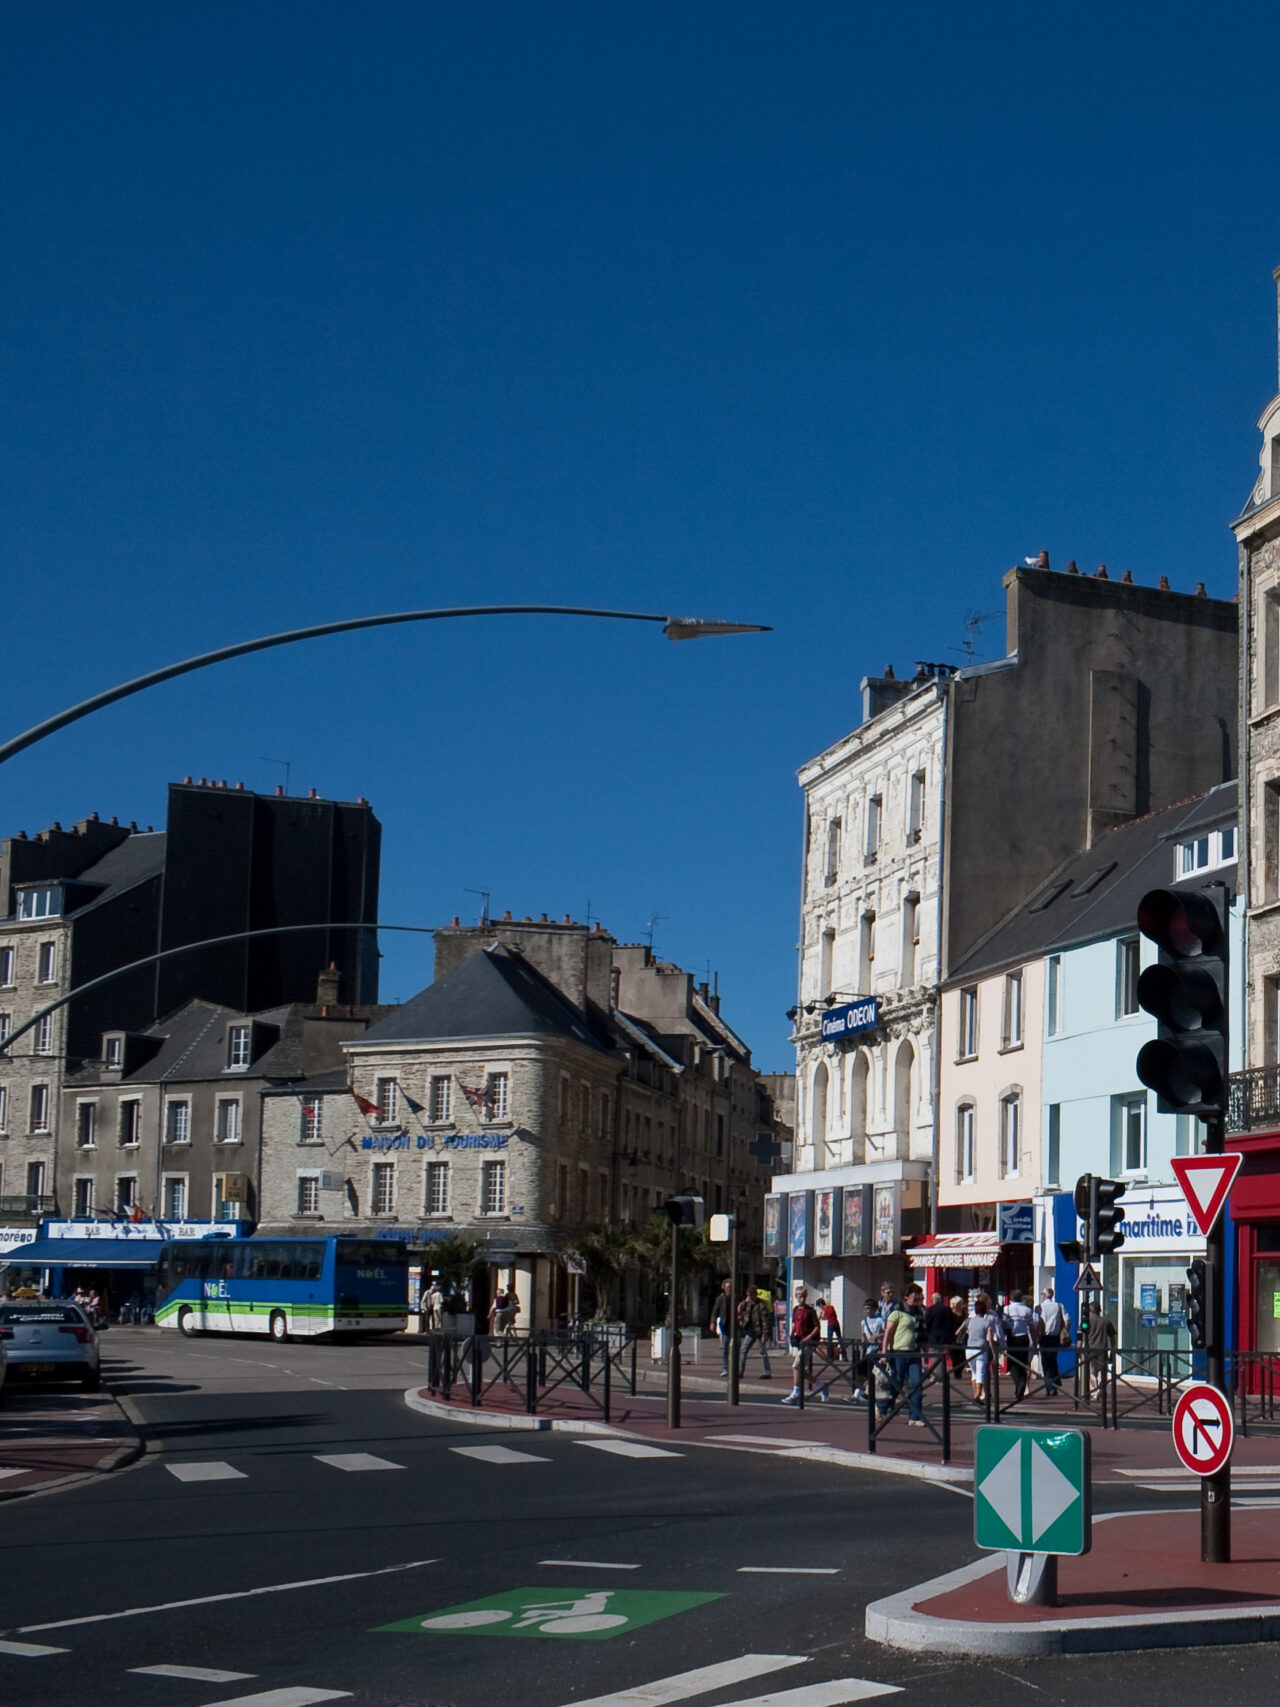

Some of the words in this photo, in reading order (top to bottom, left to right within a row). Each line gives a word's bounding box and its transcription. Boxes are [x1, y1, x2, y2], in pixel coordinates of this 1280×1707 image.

[847, 1003, 875, 1029] ODEON
[417, 1136, 434, 1150] DU
[443, 1134, 509, 1150] TOURISME
[1120, 1213, 1183, 1238] maritime
[935, 1254, 963, 1267] BOURSE
